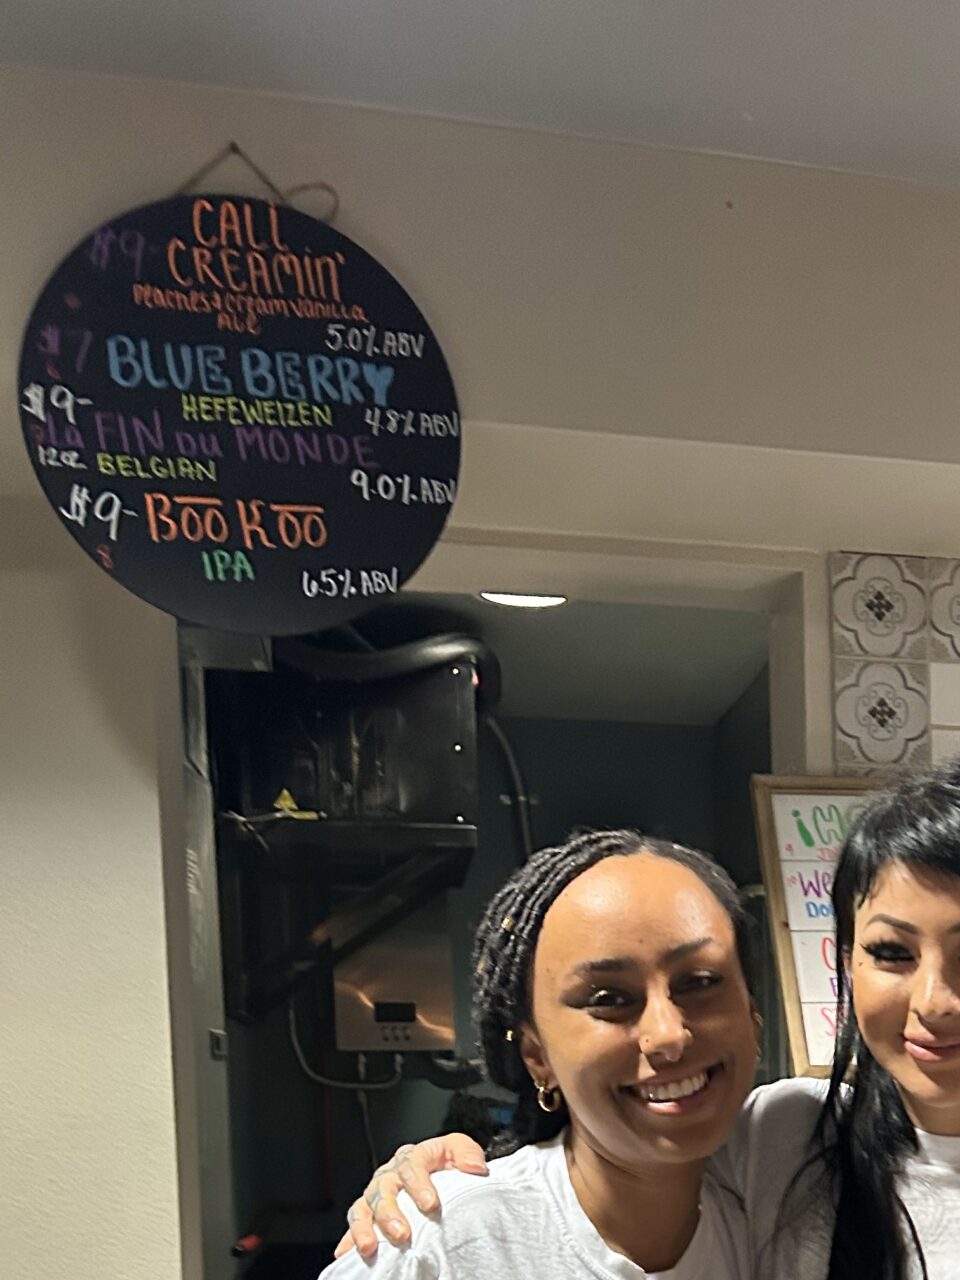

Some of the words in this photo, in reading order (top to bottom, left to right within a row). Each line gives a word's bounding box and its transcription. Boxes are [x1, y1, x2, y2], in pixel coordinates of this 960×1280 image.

[383, 331, 426, 359] ABV
[106, 334, 233, 396] BLUE
[240, 347, 396, 407] BERRY
[181, 394, 334, 428] HEFEWEIZEN
[419, 411, 459, 437] ABV
[94, 408, 167, 457] FIN
[234, 427, 384, 469] MONDE
[96, 451, 218, 482] BELGIAN
[419, 476, 459, 505] ABV
[200, 549, 256, 582] IPA
[359, 565, 398, 597] ABV
